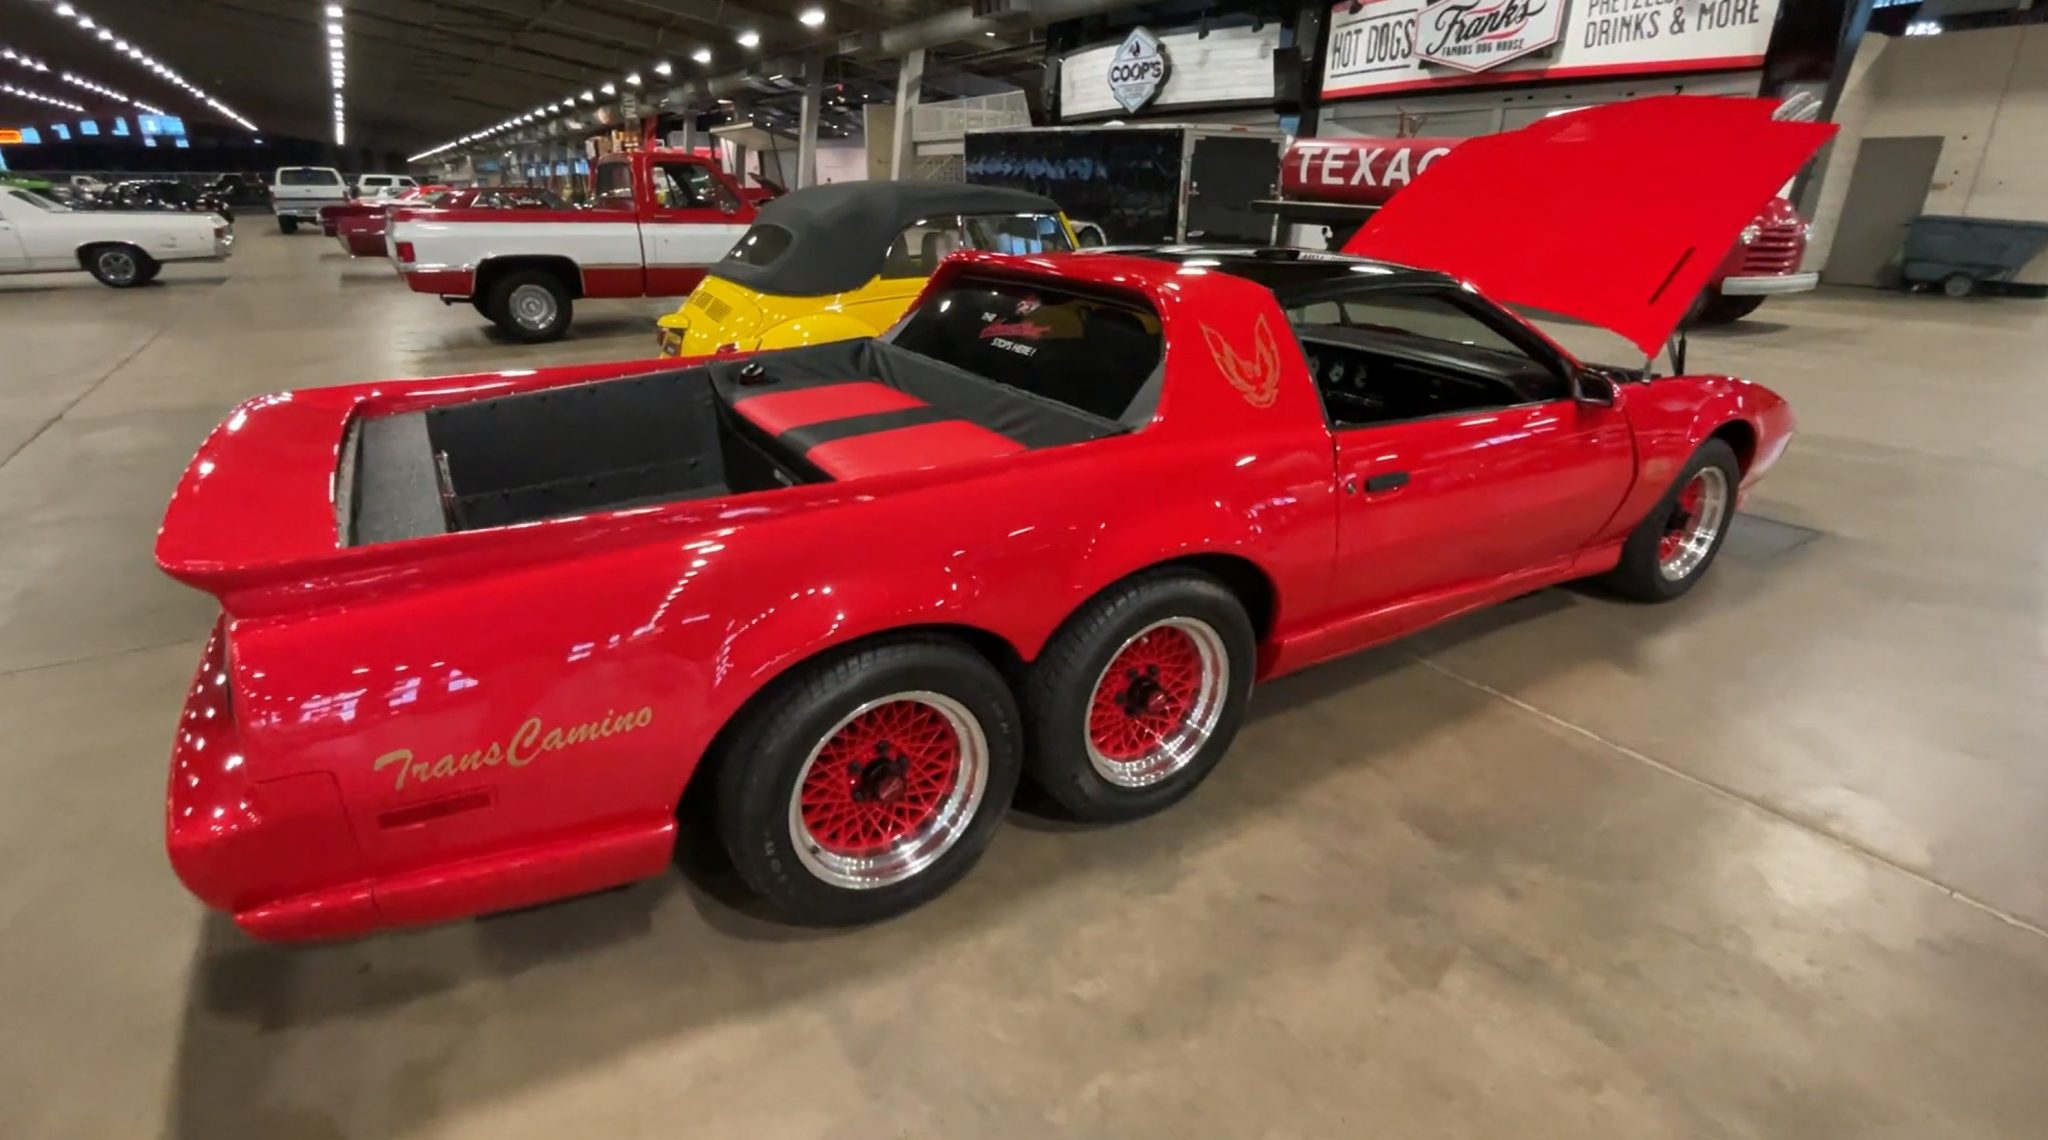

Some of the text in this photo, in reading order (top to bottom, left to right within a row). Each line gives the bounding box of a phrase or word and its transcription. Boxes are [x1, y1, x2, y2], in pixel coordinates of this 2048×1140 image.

[1587, 0, 1680, 17] PRET,
[1584, 0, 1760, 49] DRINKS & MORE
[1331, 18, 1415, 70] HOT DOGS
[1442, 44, 1472, 57] FAMOUS
[1496, 38, 1525, 52] HOUSE
[1110, 61, 1162, 83] COOP'S
[990, 337, 1014, 350] STOPS
